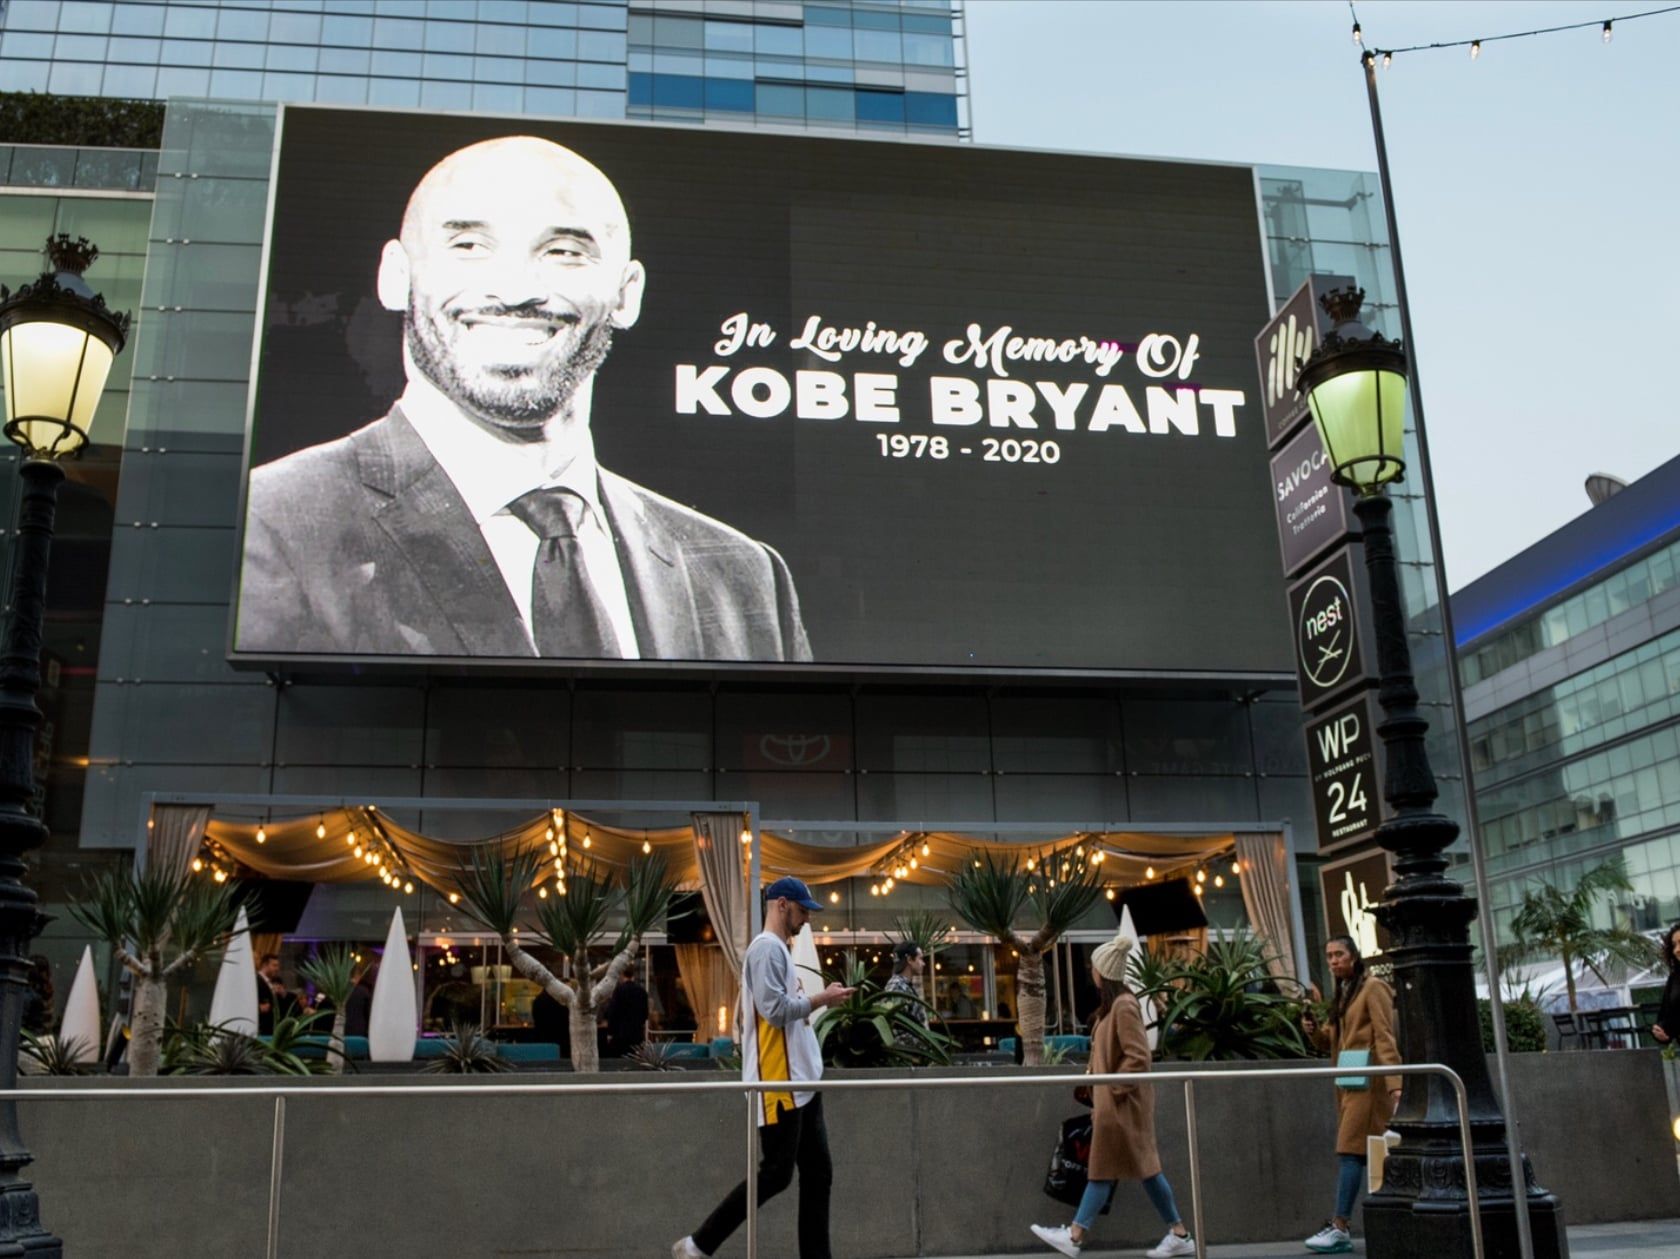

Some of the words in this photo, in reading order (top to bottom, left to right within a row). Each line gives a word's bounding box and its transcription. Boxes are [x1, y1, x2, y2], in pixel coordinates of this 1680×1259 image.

[714, 312, 777, 357] In
[789, 315, 929, 368] Loving
[942, 323, 1124, 378] Memory
[1135, 333, 1200, 380] Of
[675, 364, 901, 423] KOBE
[929, 375, 1246, 438] BRYANT
[876, 433, 950, 460] 1978
[981, 437, 1061, 464] 2020
[1286, 485, 1329, 524] Californian
[1292, 504, 1327, 535] Trattoria
[1305, 596, 1344, 640] nest
[1316, 713, 1360, 763] WP
[1327, 772, 1368, 824] 24
[1331, 818, 1369, 838] RESTAURANT
